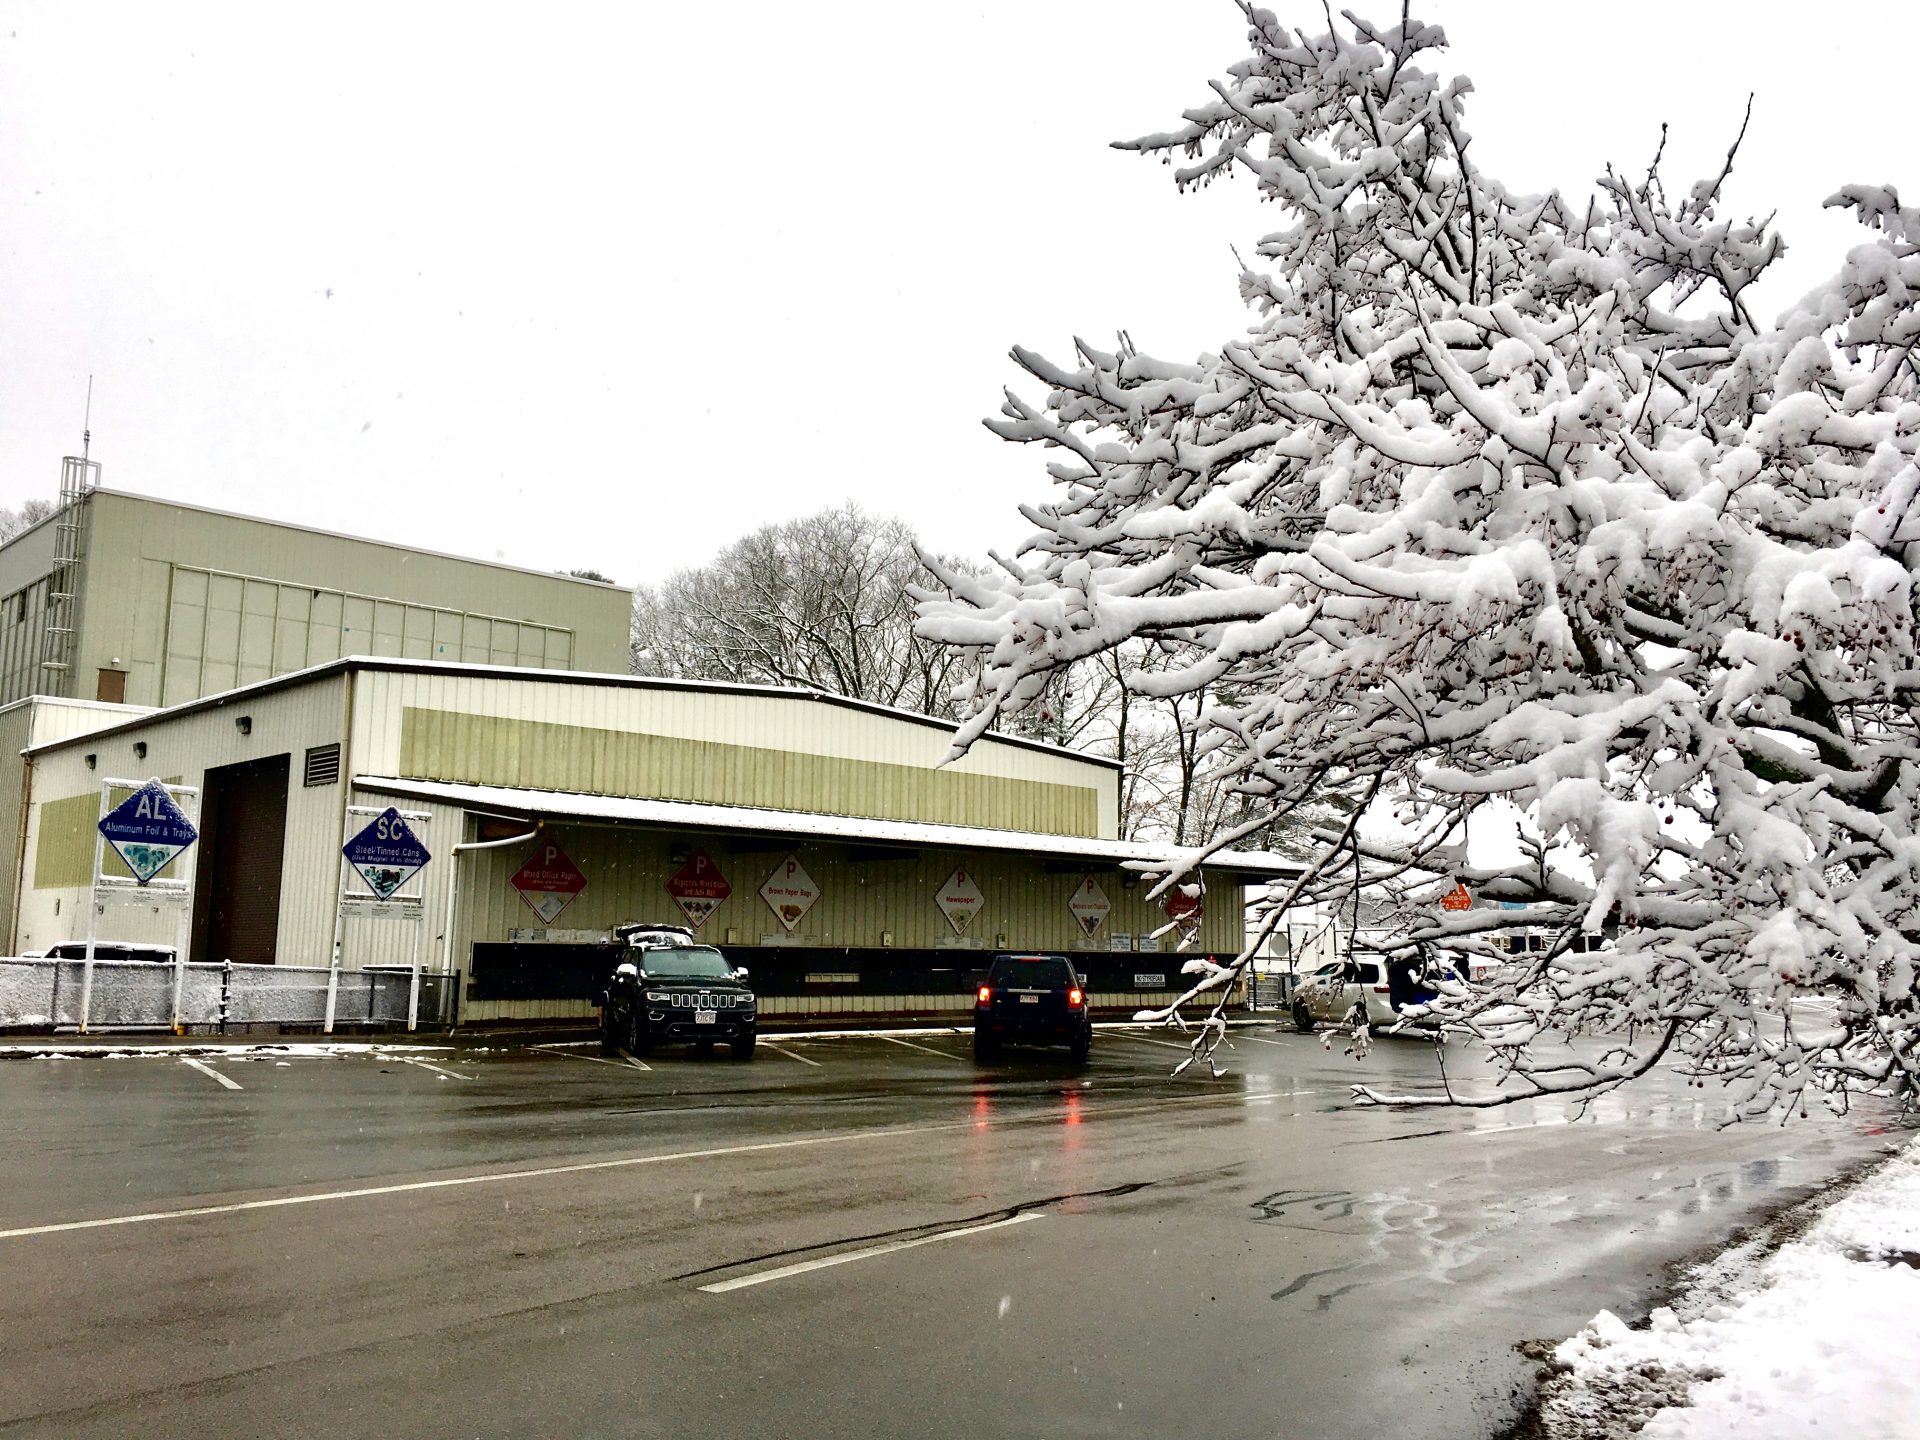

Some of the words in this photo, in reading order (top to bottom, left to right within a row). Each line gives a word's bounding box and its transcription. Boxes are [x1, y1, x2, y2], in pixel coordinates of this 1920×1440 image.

[134, 794, 167, 821] AL
[105, 822, 143, 834] Aluminum
[145, 825, 161, 836] Foil
[162, 827, 168, 836] &
[172, 827, 192, 840] Trays
[376, 816, 403, 841] SC
[367, 855, 388, 863] Magnet
[402, 848, 420, 857] Cans
[545, 846, 557, 866] P
[696, 855, 707, 874] P
[787, 861, 796, 879] P
[523, 869, 540, 879] Mixed
[541, 870, 559, 879] Office
[561, 871, 577, 880] Paper
[957, 872, 965, 888] P
[768, 887, 784, 895] Brown
[785, 888, 799, 897] Paper
[800, 889, 812, 898] Bags
[1087, 879, 1094, 894] P
[945, 896, 976, 905] Newspaper
